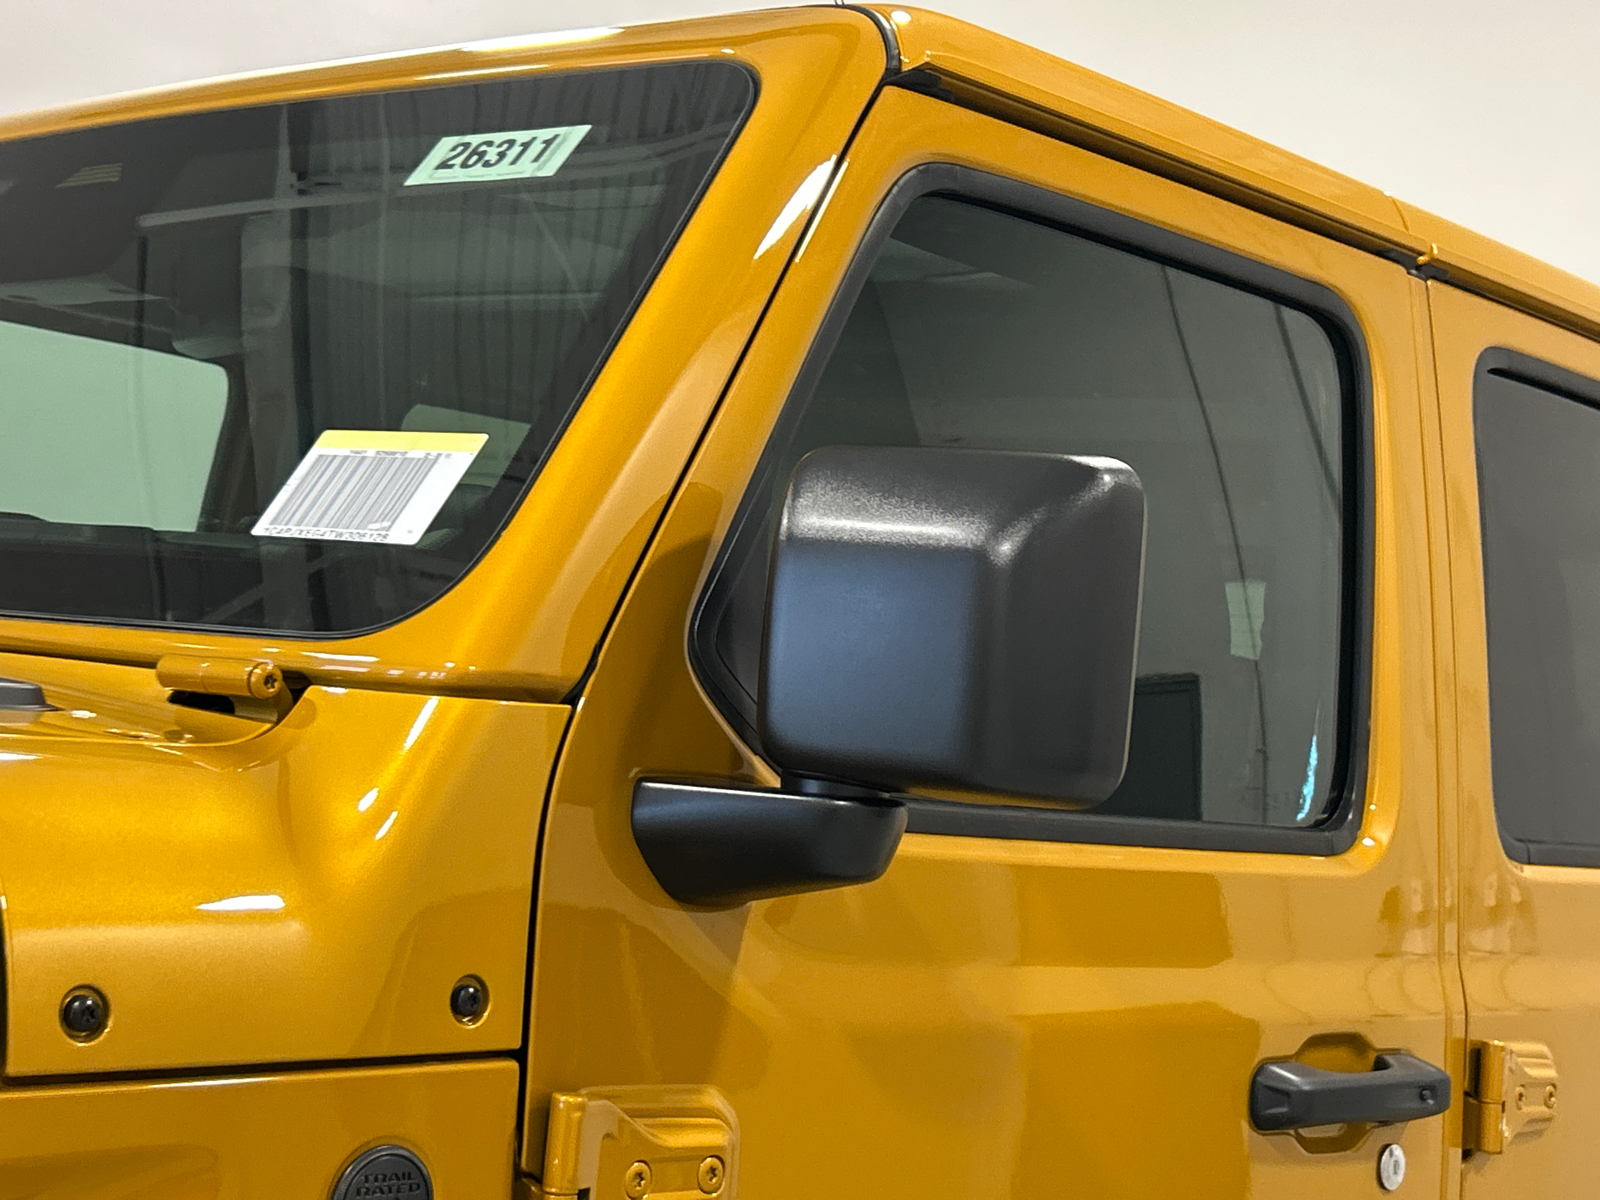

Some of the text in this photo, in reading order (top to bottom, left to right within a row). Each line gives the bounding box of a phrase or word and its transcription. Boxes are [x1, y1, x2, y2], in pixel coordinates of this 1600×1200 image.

[434, 134, 561, 171] 26311
[362, 1171, 417, 1184] TRAIL
[356, 1182, 421, 1197] RATED
